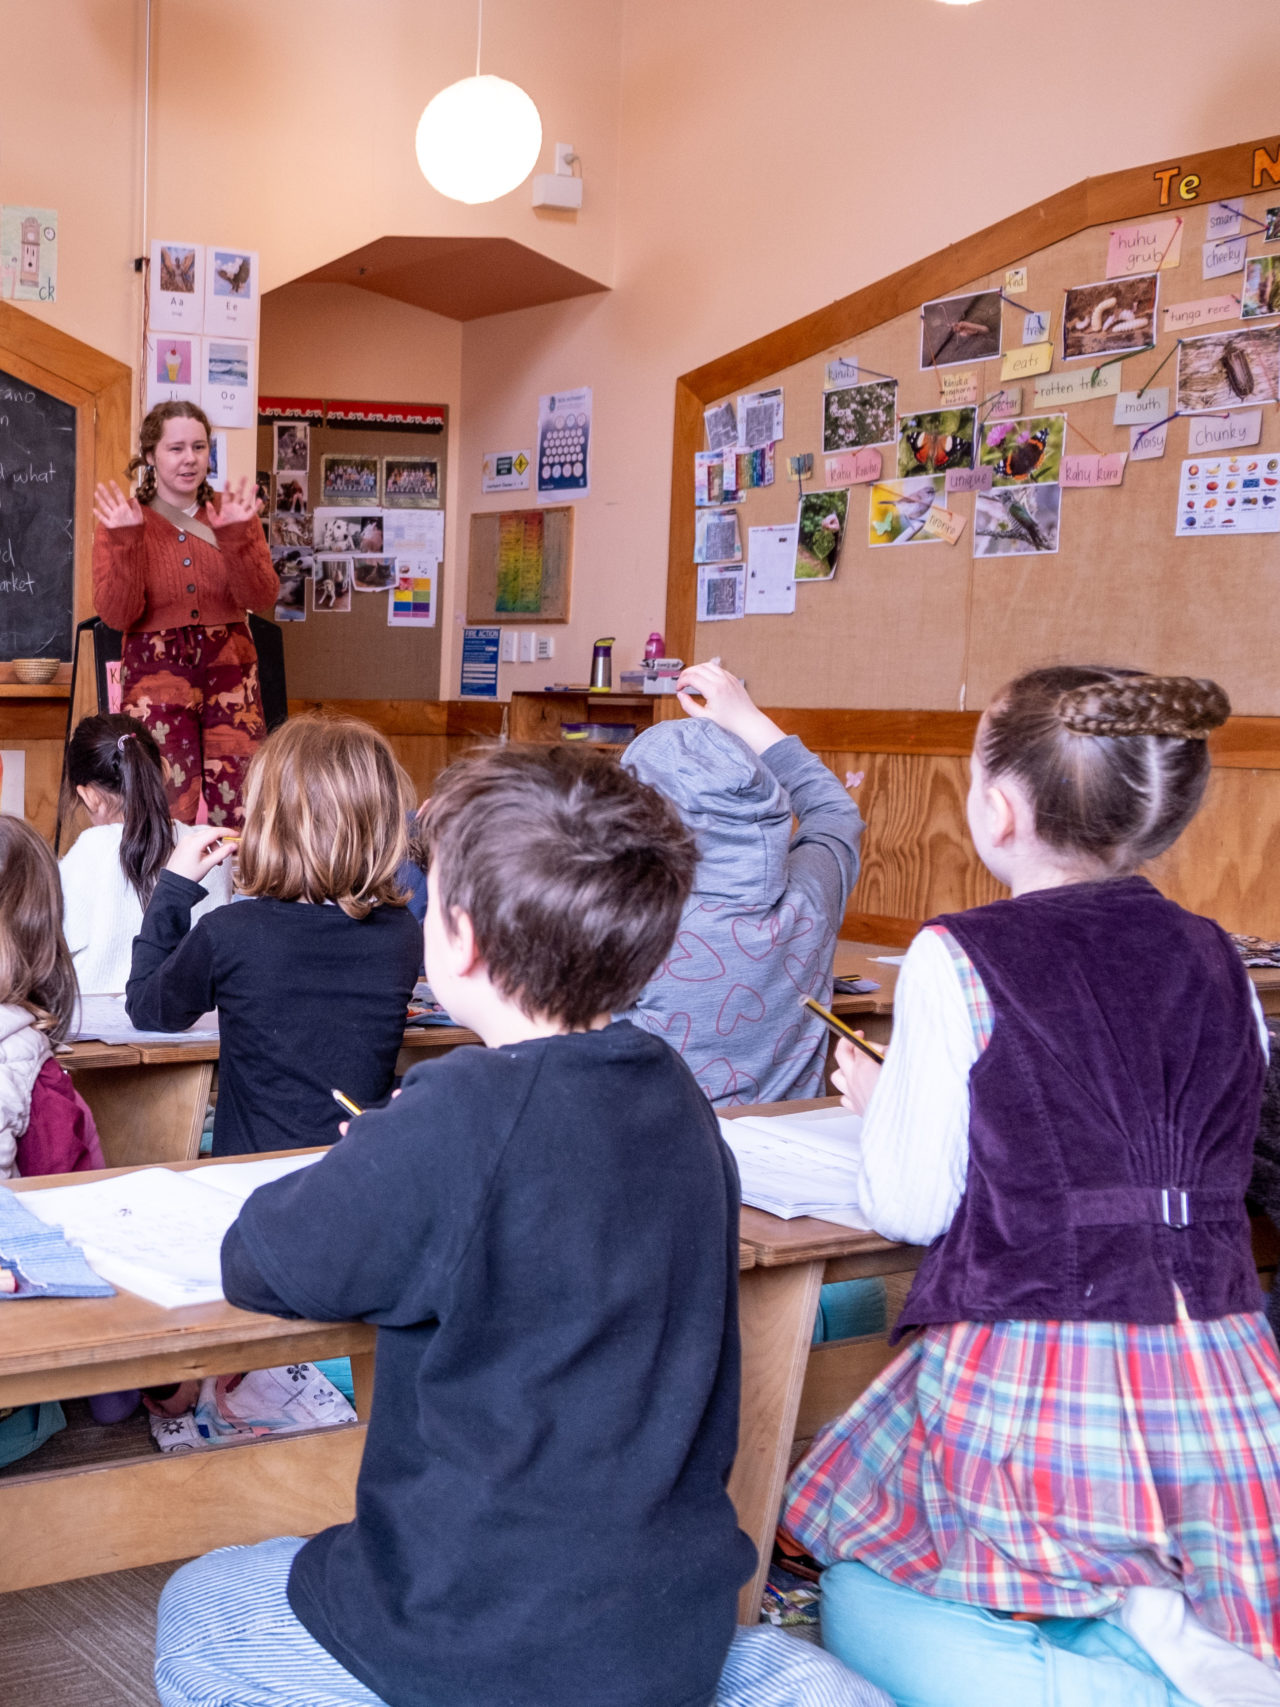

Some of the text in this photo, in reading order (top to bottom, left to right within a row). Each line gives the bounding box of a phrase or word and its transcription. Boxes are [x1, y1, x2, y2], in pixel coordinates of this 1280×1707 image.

[1154, 166, 1201, 206] Te
[1210, 208, 1240, 229] smart
[1118, 230, 1157, 249] huhu
[1127, 250, 1164, 270] grub
[1206, 247, 1240, 268] cheeky
[39, 276, 55, 301] ck
[1171, 309, 1201, 326] tunga
[1013, 353, 1039, 371] eats
[1040, 381, 1073, 397] rotten
[1125, 398, 1160, 413] mouth
[1195, 424, 1247, 446] chunky
[13, 461, 57, 484] what
[950, 473, 987, 489] unique
